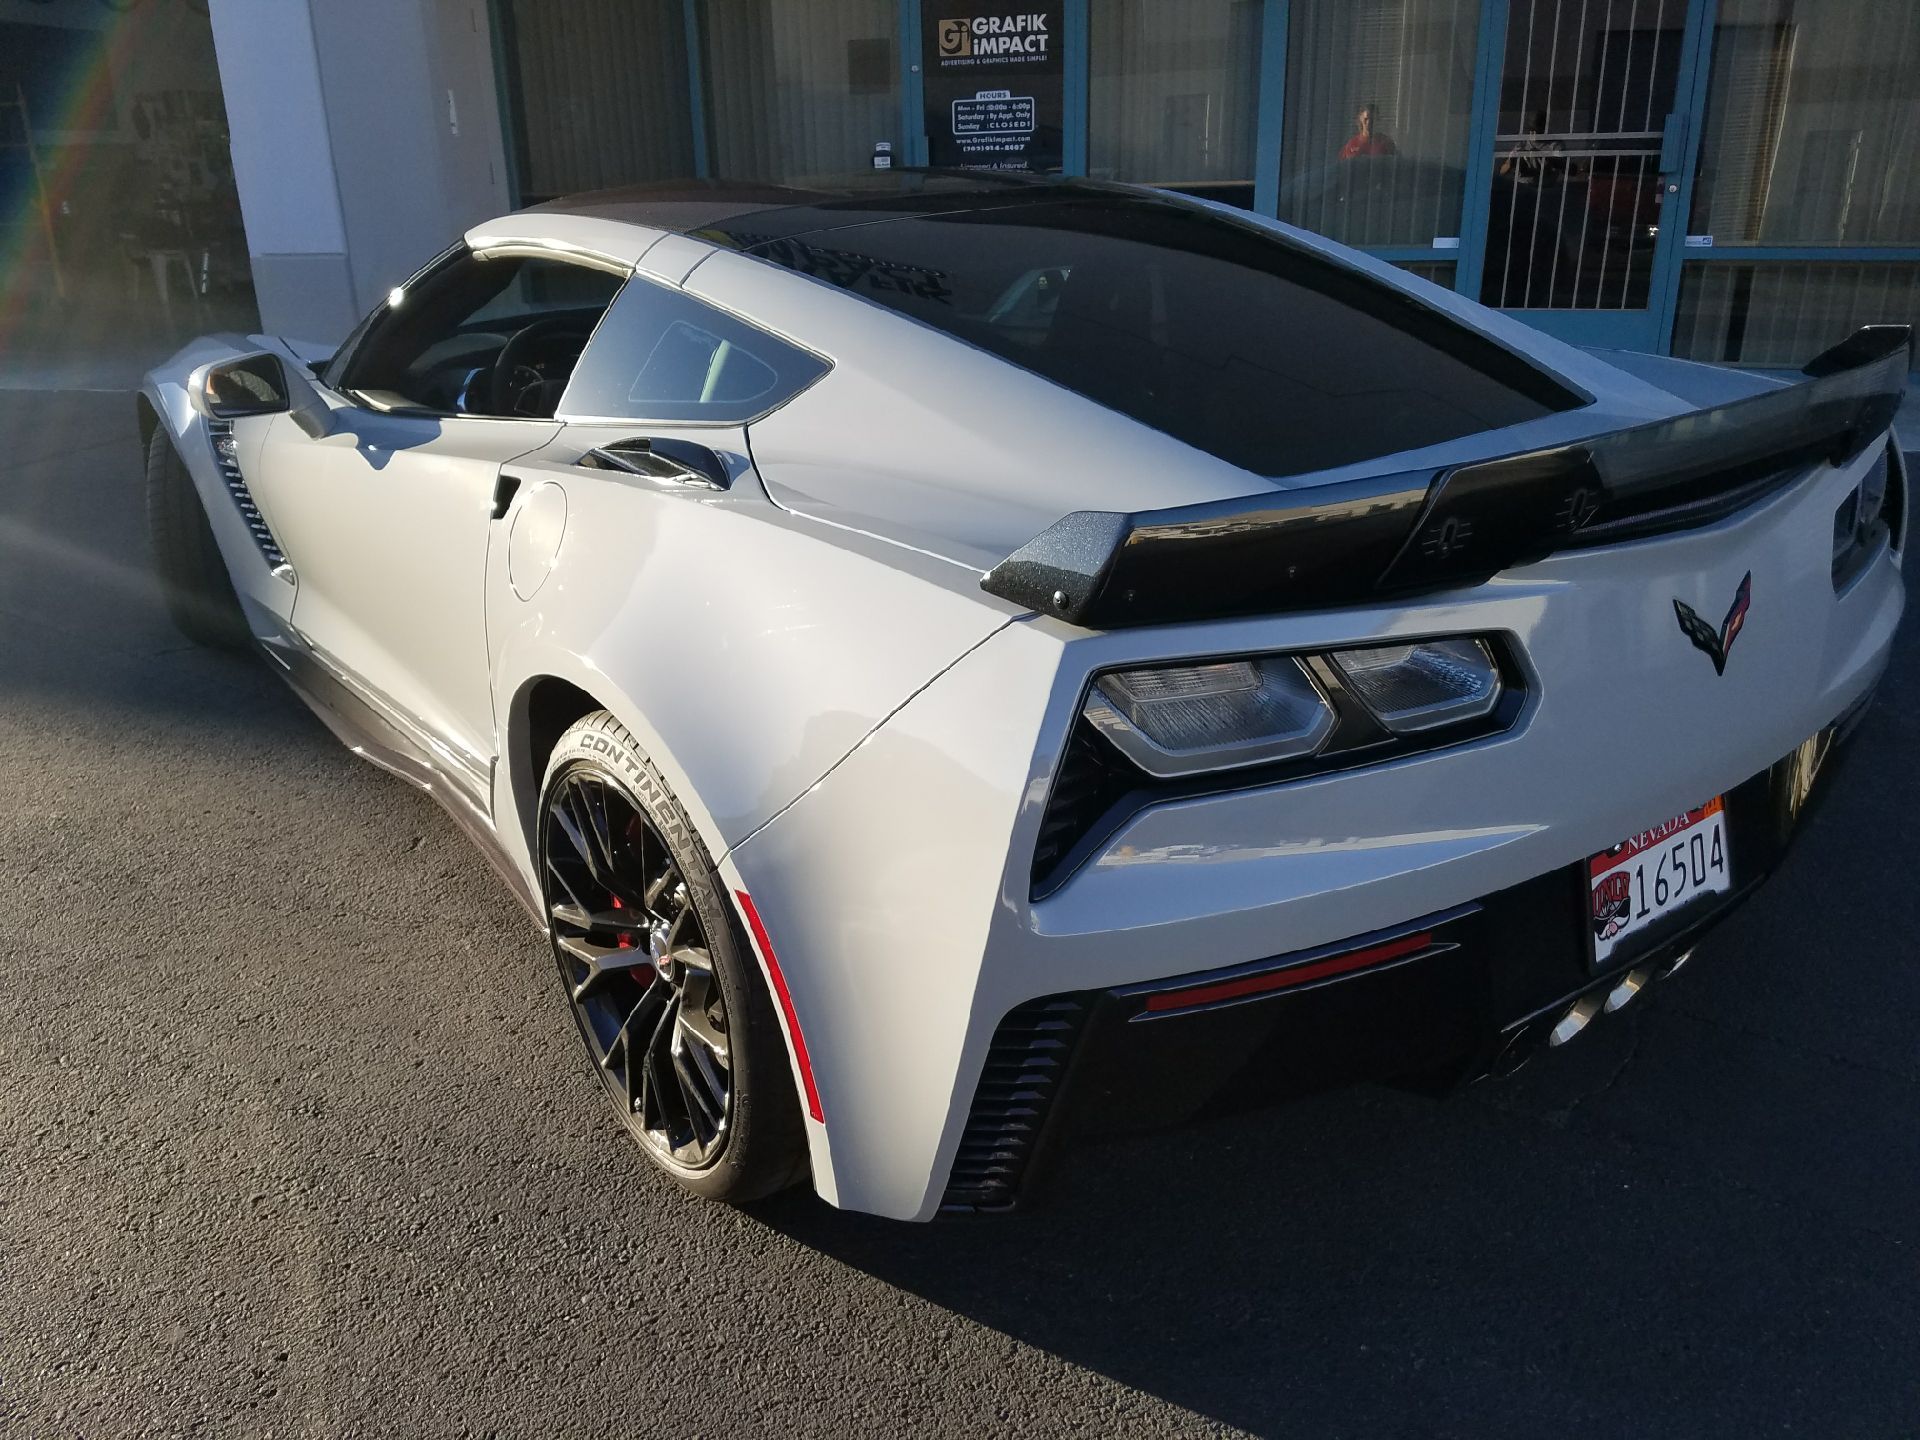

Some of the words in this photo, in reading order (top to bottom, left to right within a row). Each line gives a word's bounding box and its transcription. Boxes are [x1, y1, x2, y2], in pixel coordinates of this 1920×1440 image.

[972, 14, 1047, 35] GRAFIK
[941, 58, 975, 66] ADVERTISING
[1010, 55, 1025, 63] MADE
[957, 113, 985, 121] Saturday
[1016, 110, 1031, 119] Only
[957, 122, 980, 131] Sunday
[1627, 812, 1690, 855] NEVADA
[1635, 823, 1724, 920] 16504
